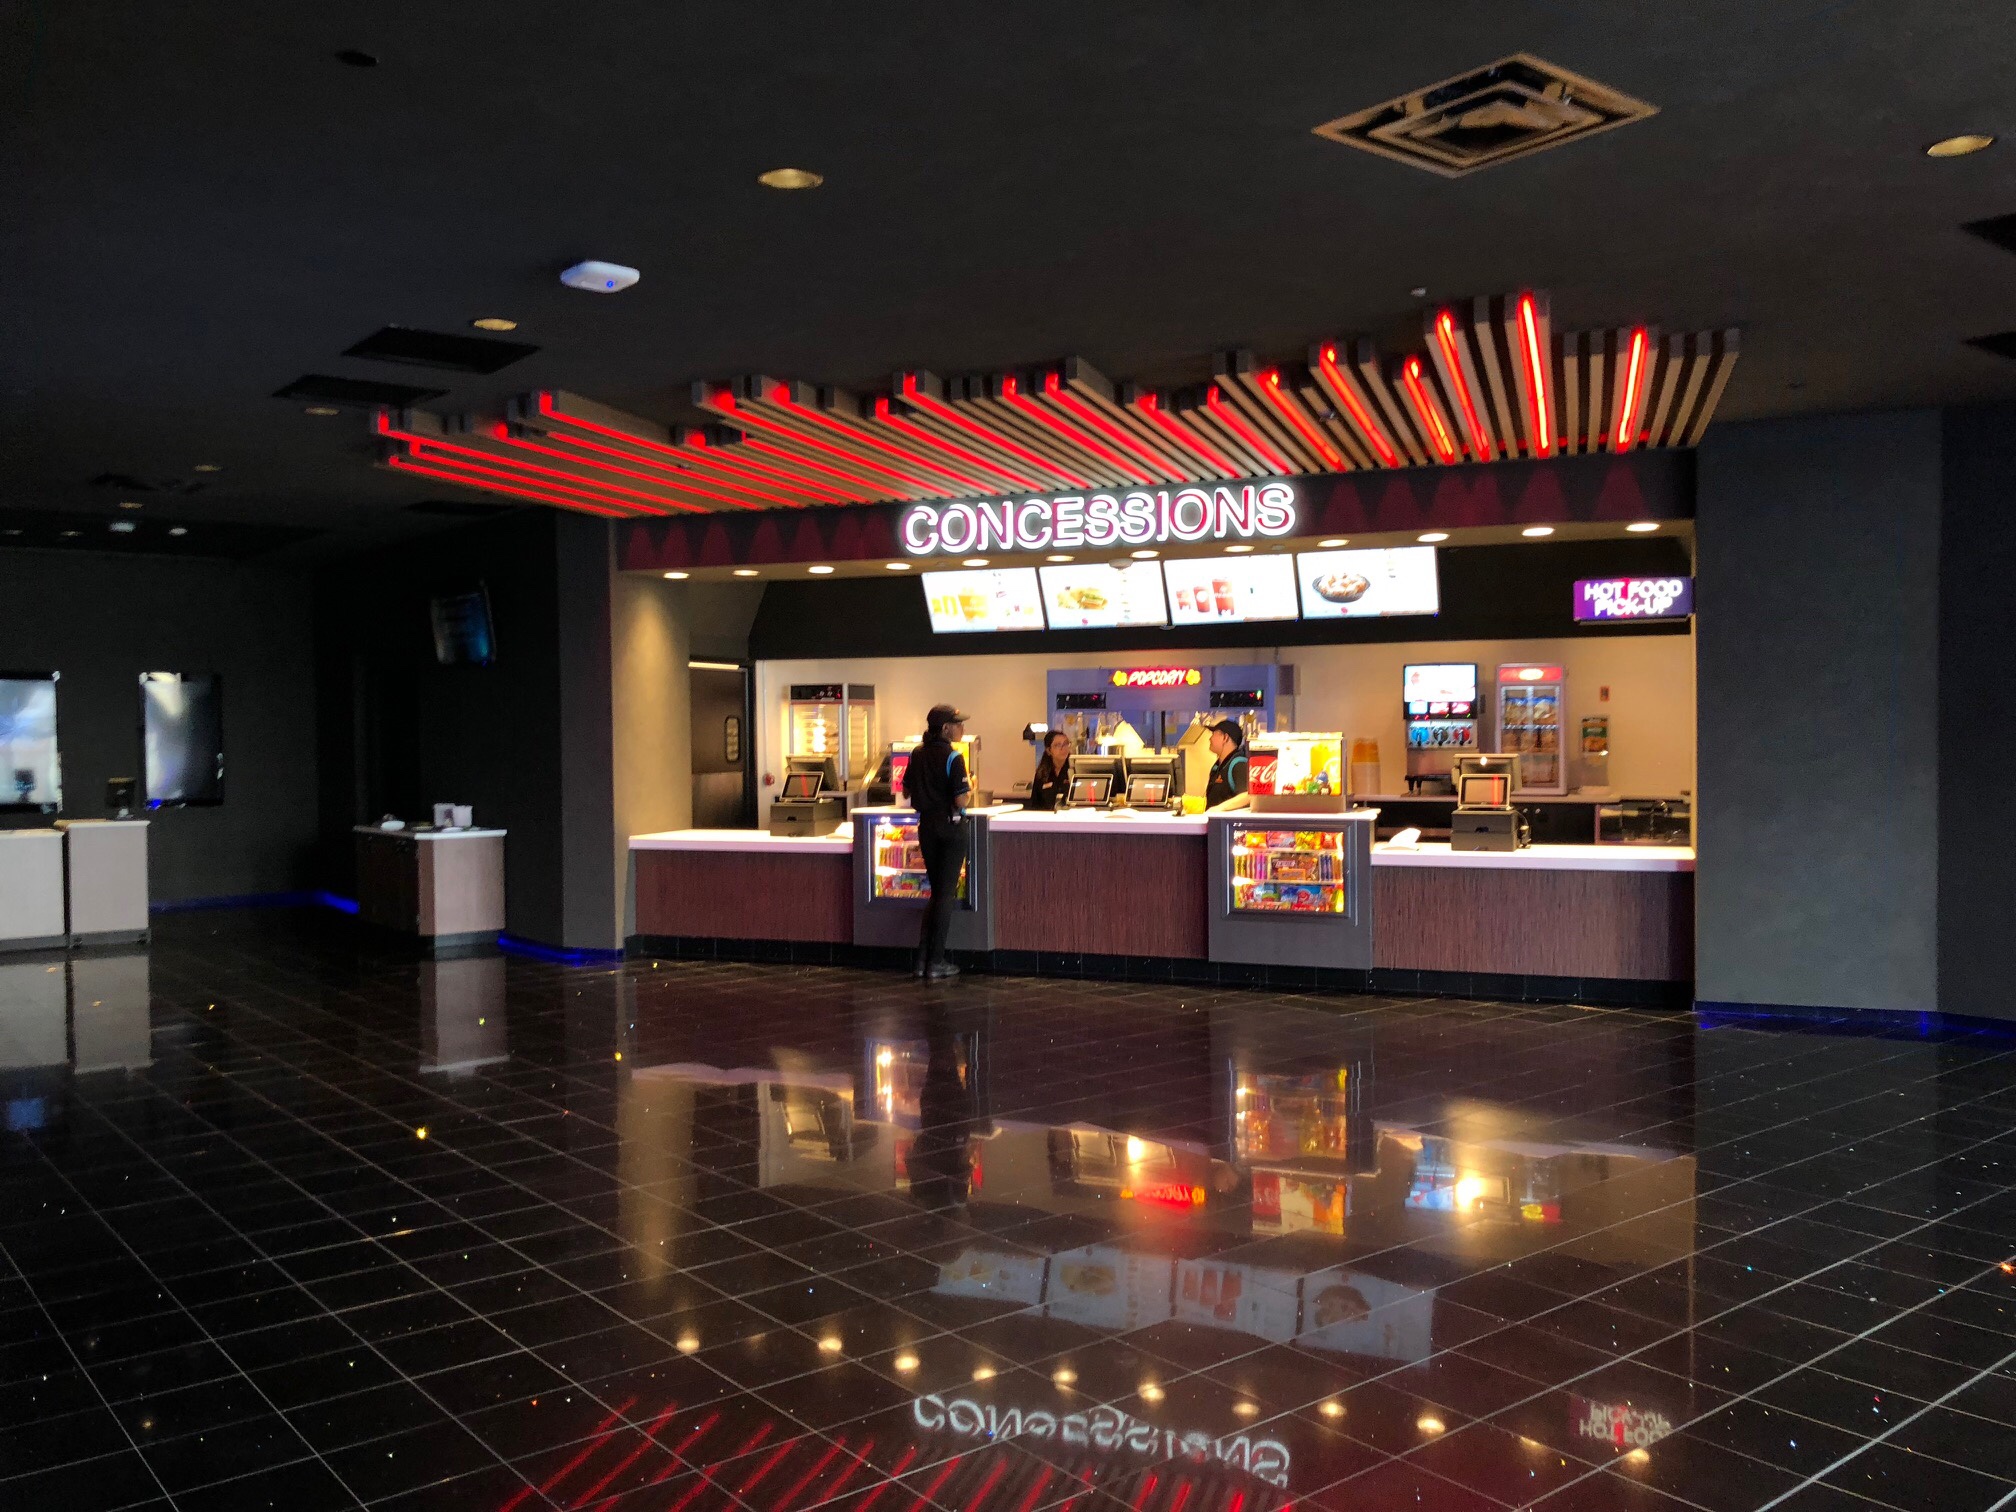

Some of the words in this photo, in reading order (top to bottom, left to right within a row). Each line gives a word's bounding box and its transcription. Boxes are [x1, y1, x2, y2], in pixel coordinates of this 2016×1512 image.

[901, 483, 1297, 555] CONCESSIONS
[1584, 583, 1625, 601] HOT
[1628, 579, 1683, 599] FOOD
[1127, 669, 1186, 686] POPCORN
